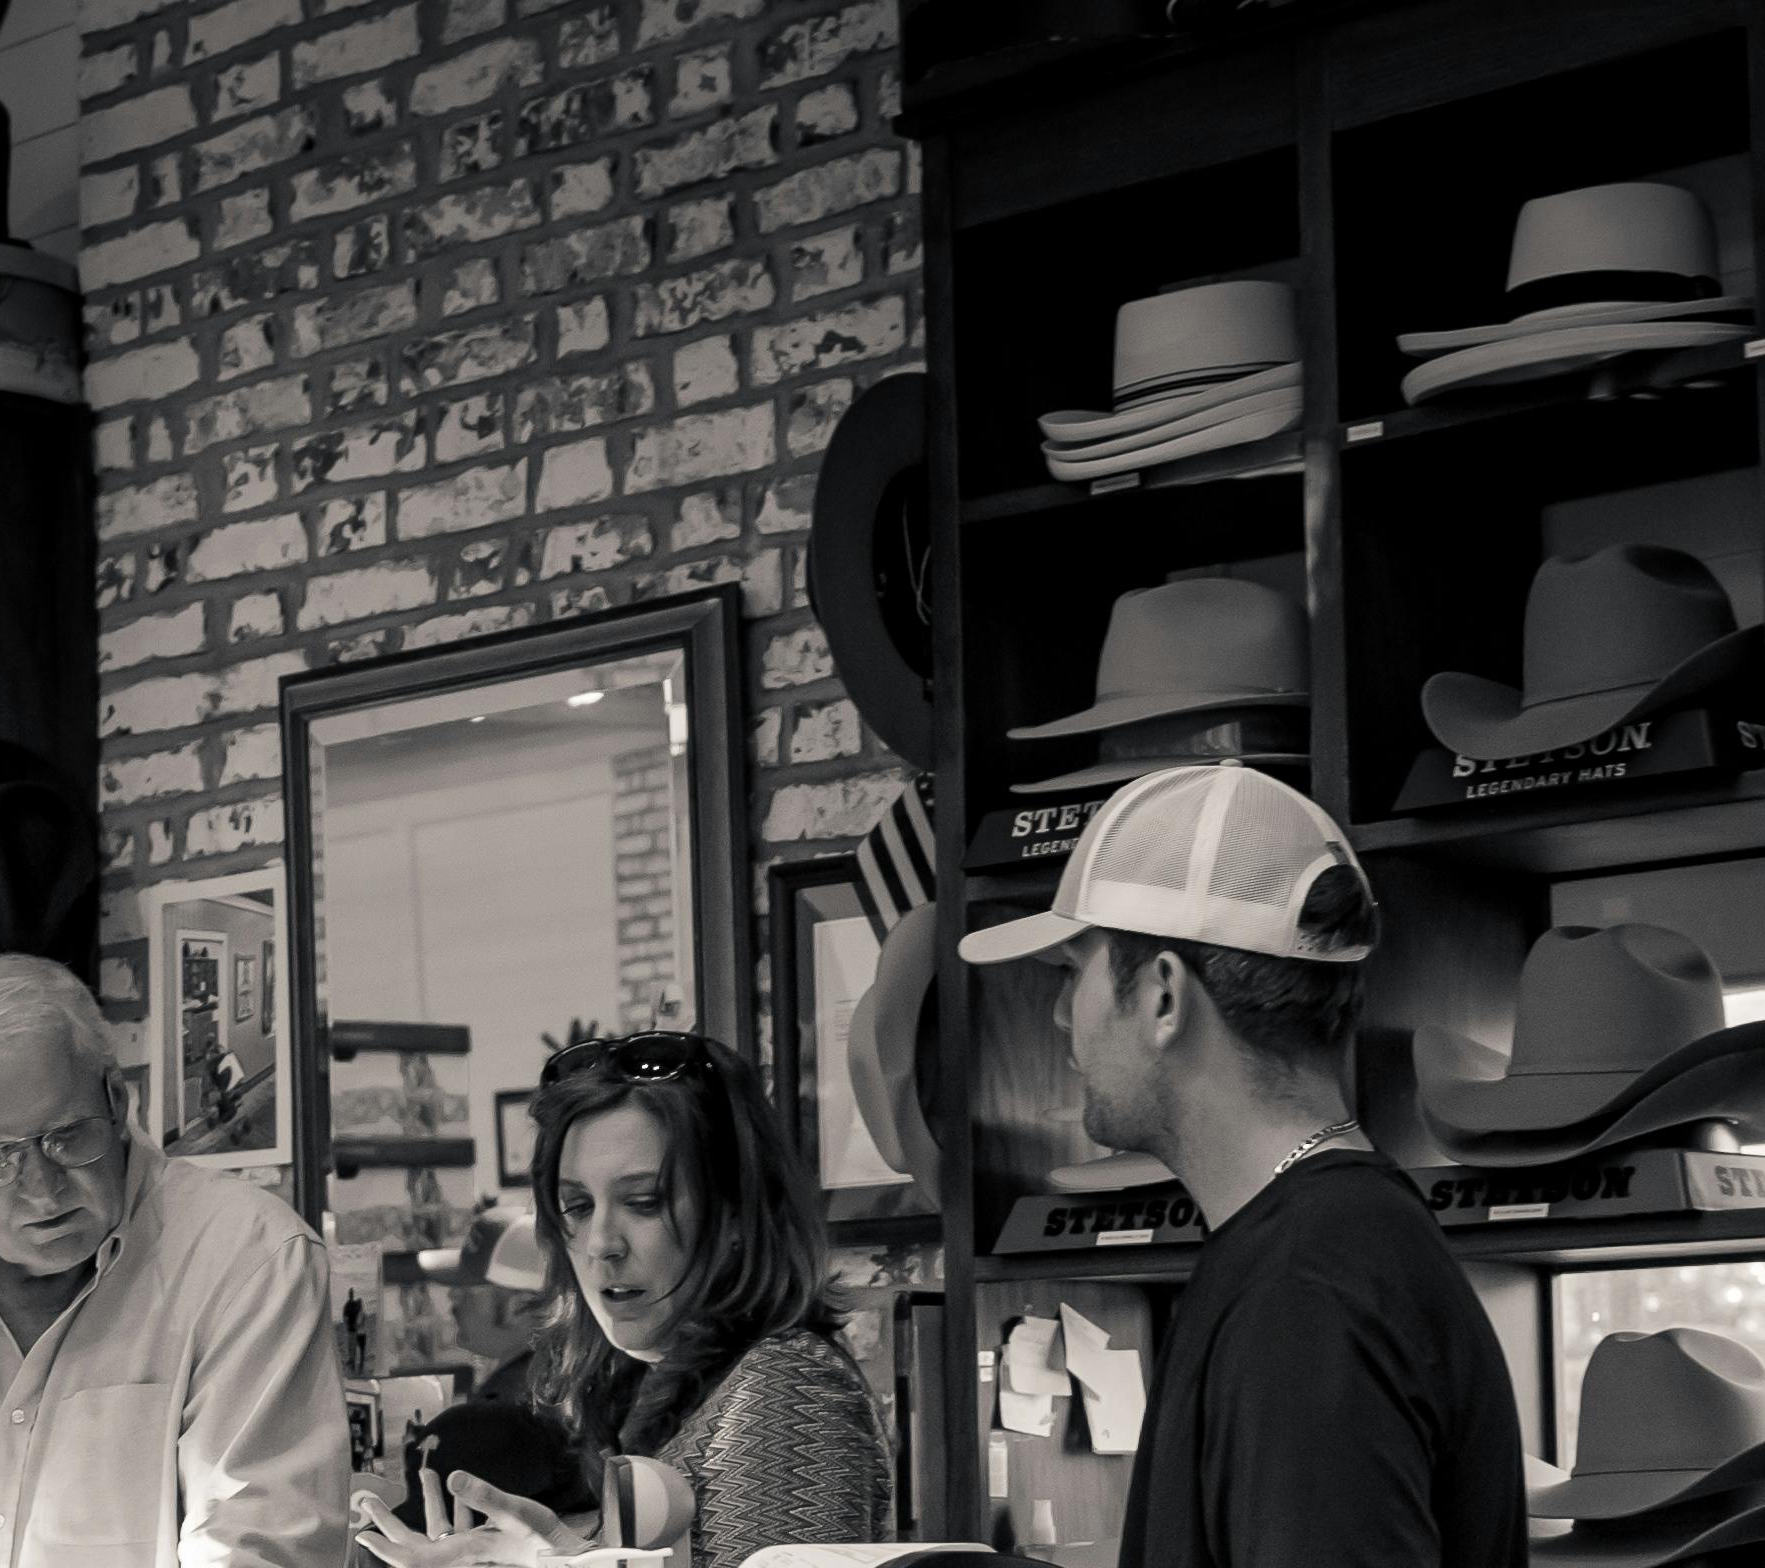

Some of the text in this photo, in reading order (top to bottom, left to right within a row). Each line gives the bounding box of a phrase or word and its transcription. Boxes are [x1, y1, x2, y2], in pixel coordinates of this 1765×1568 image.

[1464, 762, 1628, 800] LEGENDARY HATS
[1043, 1198, 1204, 1237] STETSO
